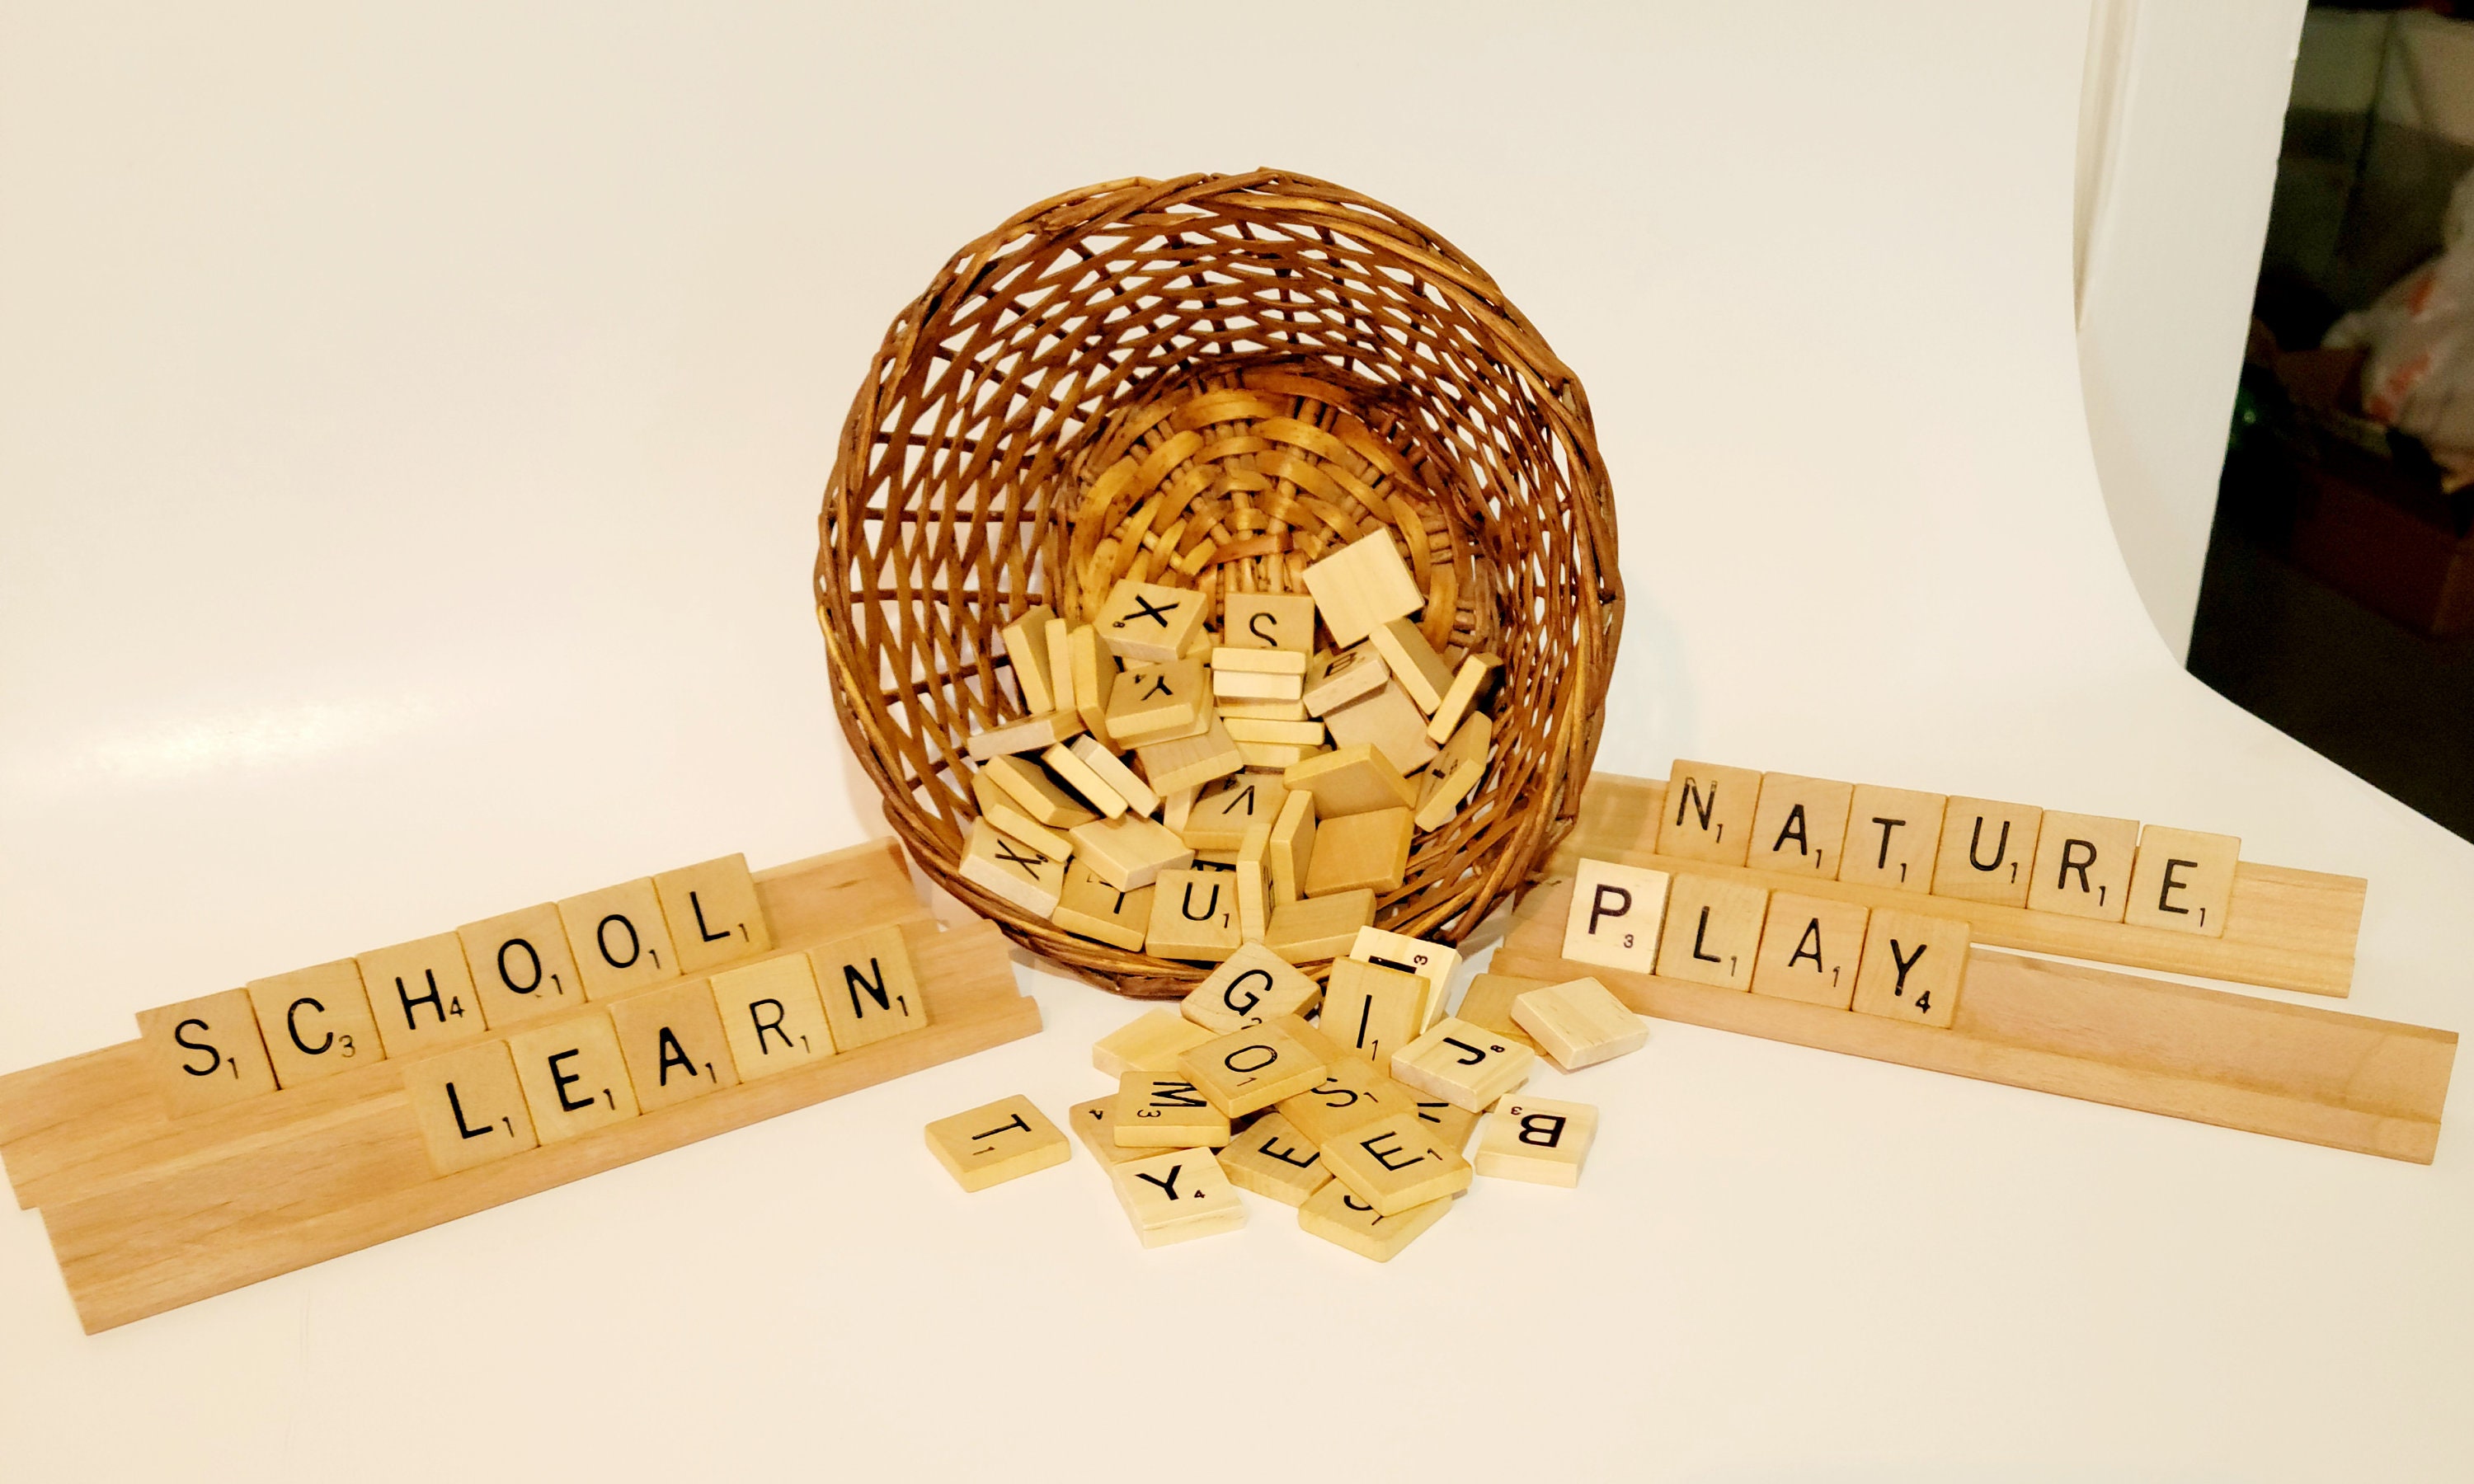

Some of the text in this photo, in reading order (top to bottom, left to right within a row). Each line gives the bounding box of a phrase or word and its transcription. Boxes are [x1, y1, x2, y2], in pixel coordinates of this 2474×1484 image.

[1122, 594, 1181, 628] X
[995, 838, 1042, 881] X
[1675, 776, 2199, 915] NATURE
[1181, 881, 1221, 922] U
[1587, 883, 1928, 997] PLAY
[173, 890, 731, 1077] SCHOOL
[1224, 969, 1273, 1017] G
[1622, 933, 1634, 949] 3
[1915, 990, 1931, 1014] 4
[445, 956, 891, 1139] LEARN
[1224, 1044, 1278, 1073] O
[1442, 1036, 1487, 1066] J
[971, 1113, 1032, 1140] T
[1517, 1113, 1568, 1148] B
[1359, 1130, 1426, 1172] E
[1134, 1164, 1183, 1201] Y
